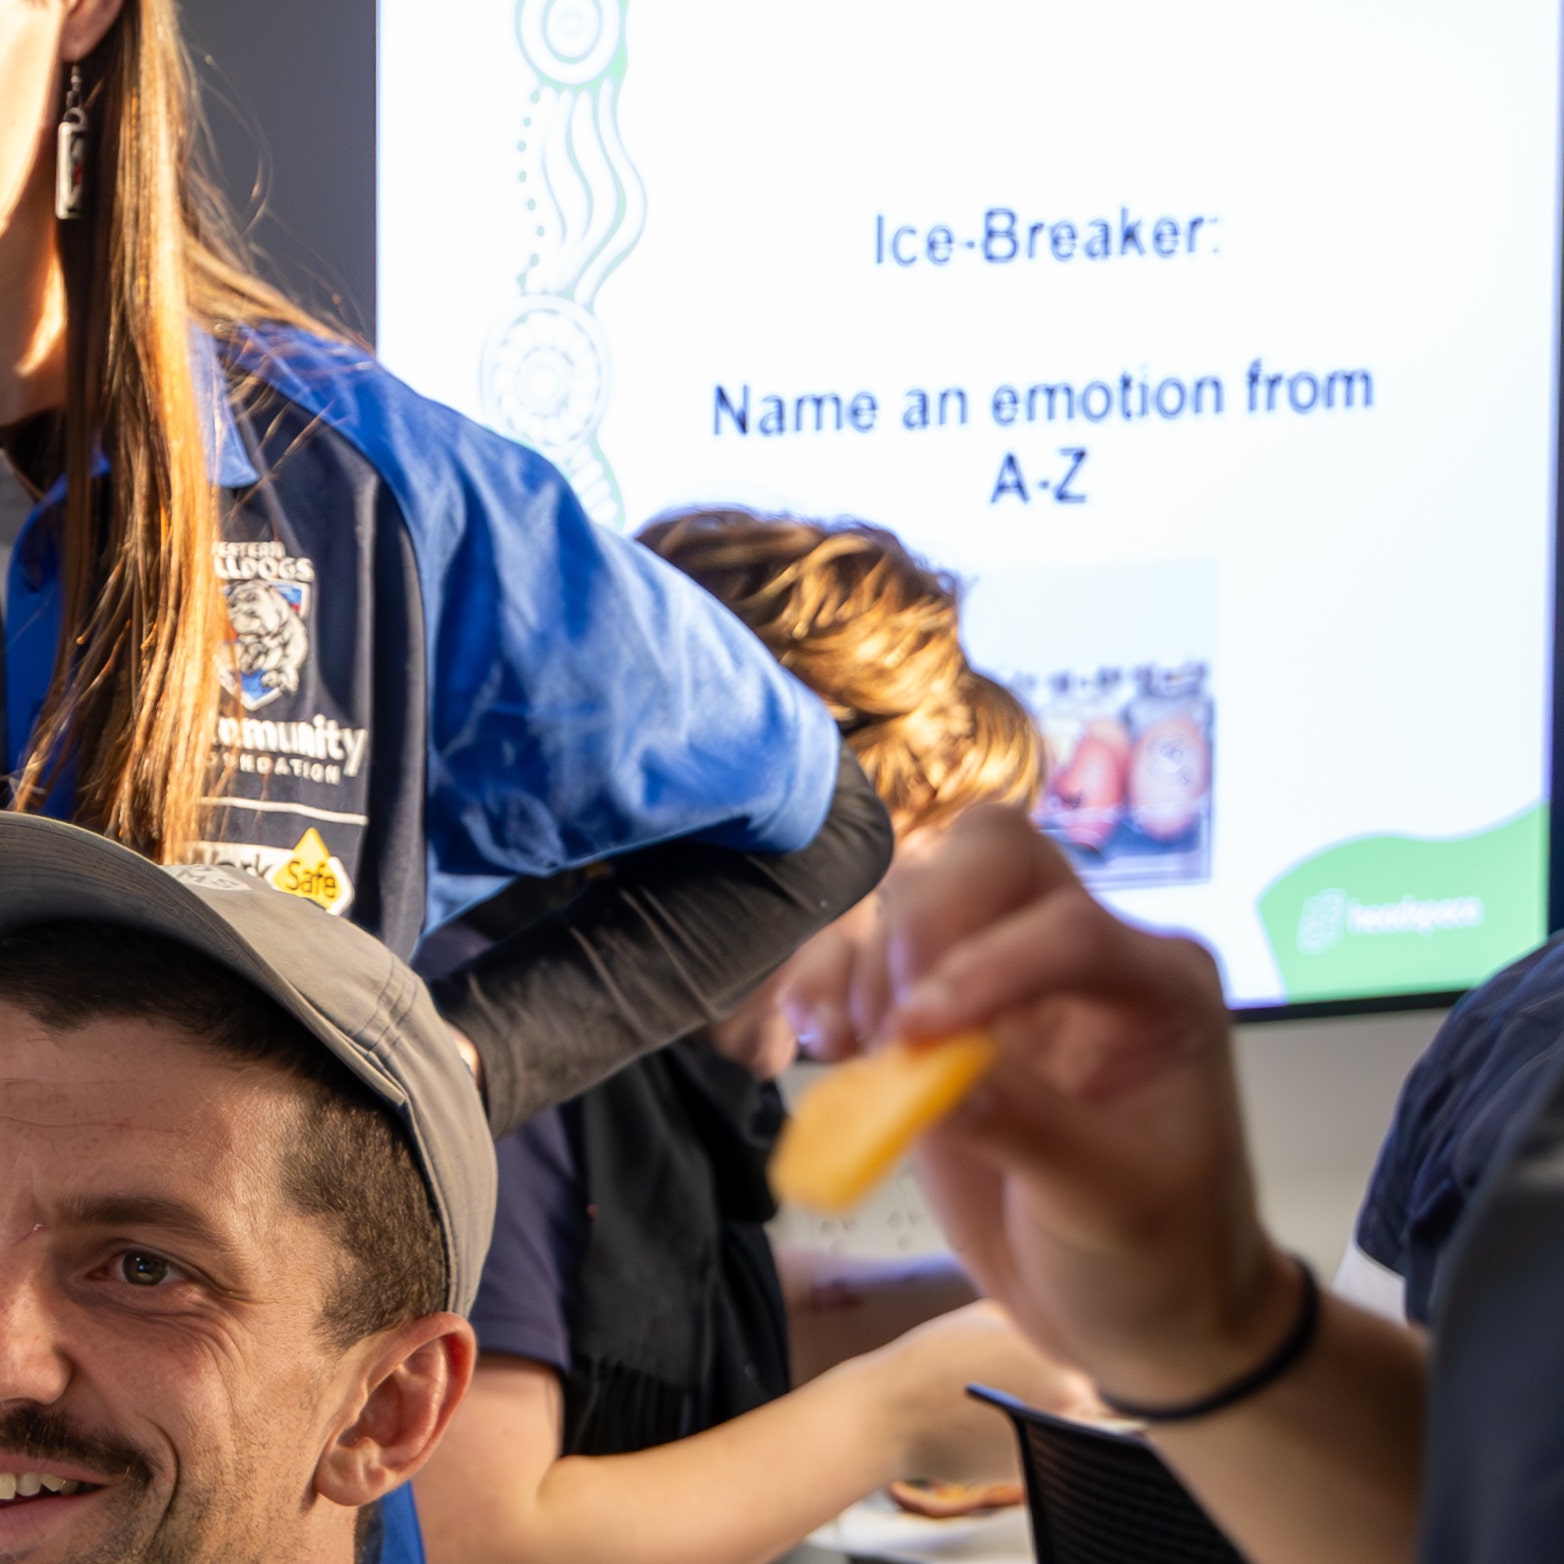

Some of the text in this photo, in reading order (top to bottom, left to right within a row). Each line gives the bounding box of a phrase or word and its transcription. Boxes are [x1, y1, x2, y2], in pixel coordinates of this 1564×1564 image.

[875, 206, 1220, 267] Ice-Breaker:
[712, 358, 1375, 437] Name an emotion from
[990, 447, 1089, 504] A-Z
[214, 556, 315, 582] LLDOGS
[217, 713, 368, 777] mmunity
